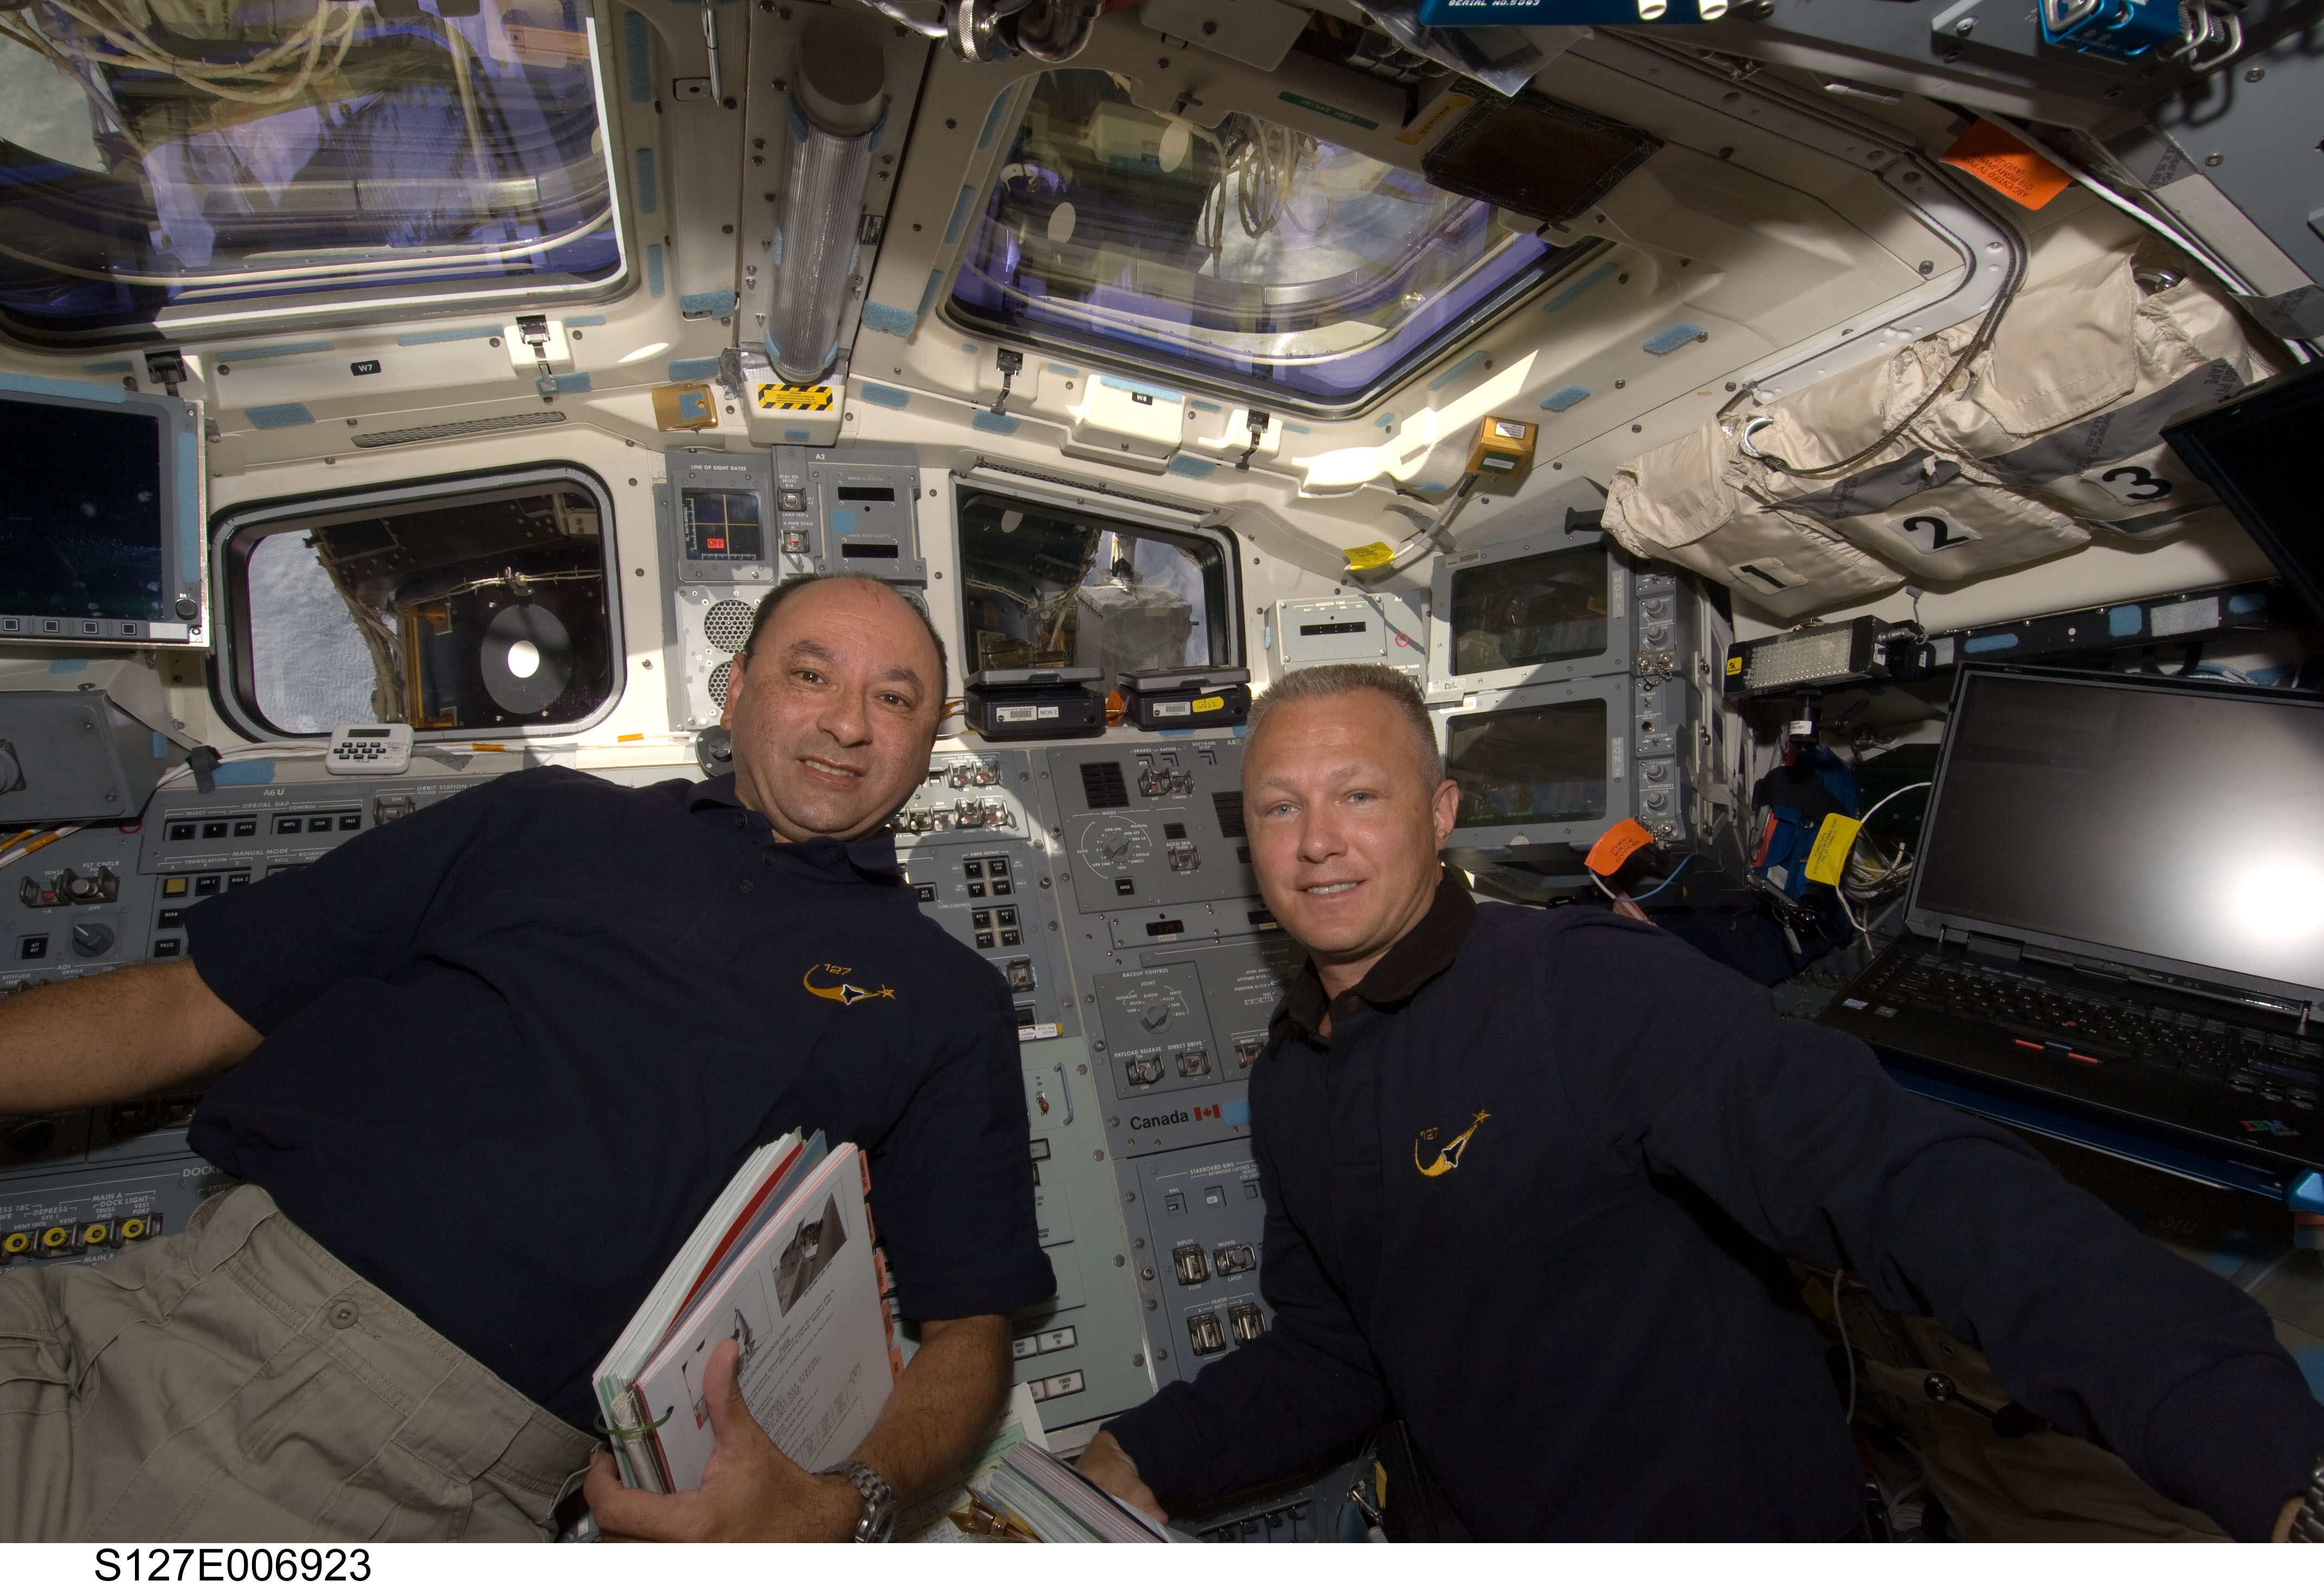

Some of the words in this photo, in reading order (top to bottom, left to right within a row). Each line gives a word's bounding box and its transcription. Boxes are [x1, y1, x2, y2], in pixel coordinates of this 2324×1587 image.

[1301, 100, 1330, 112] PRYBAR
[1979, 166, 1989, 174] TV
[358, 364, 373, 372] W7
[2204, 364, 2228, 385] TAPE
[1137, 394, 1147, 402] W8
[2102, 466, 2172, 500] 3
[1903, 516, 1969, 549] 2
[1740, 565, 1787, 588] 1
[824, 964, 852, 975] 127
[1145, 968, 1169, 976] CONTROL
[1167, 1042, 1186, 1051] DIRECT
[1114, 1050, 1139, 1059] PAYLOAD
[1140, 1046, 1162, 1054] RELEASE
[1131, 1110, 1189, 1131] Canada
[1421, 1127, 1438, 1141] 127
[1190, 1164, 1222, 1175] STARBOARD
[1232, 1164, 1250, 1173] LATCHES
[92, 1193, 115, 1201] MAIN
[100, 1199, 124, 1207] DOCK
[125, 1195, 150, 1204] LIGHT
[33, 1206, 68, 1216] DEPRESS
[1218, 1239, 1236, 1247] RELEASE
[83, 1256, 108, 1264] MAIN
[1228, 1274, 1242, 1282] LATCH
[803, 1278, 819, 1298] ELBOW
[1211, 1297, 1228, 1305] HEATER
